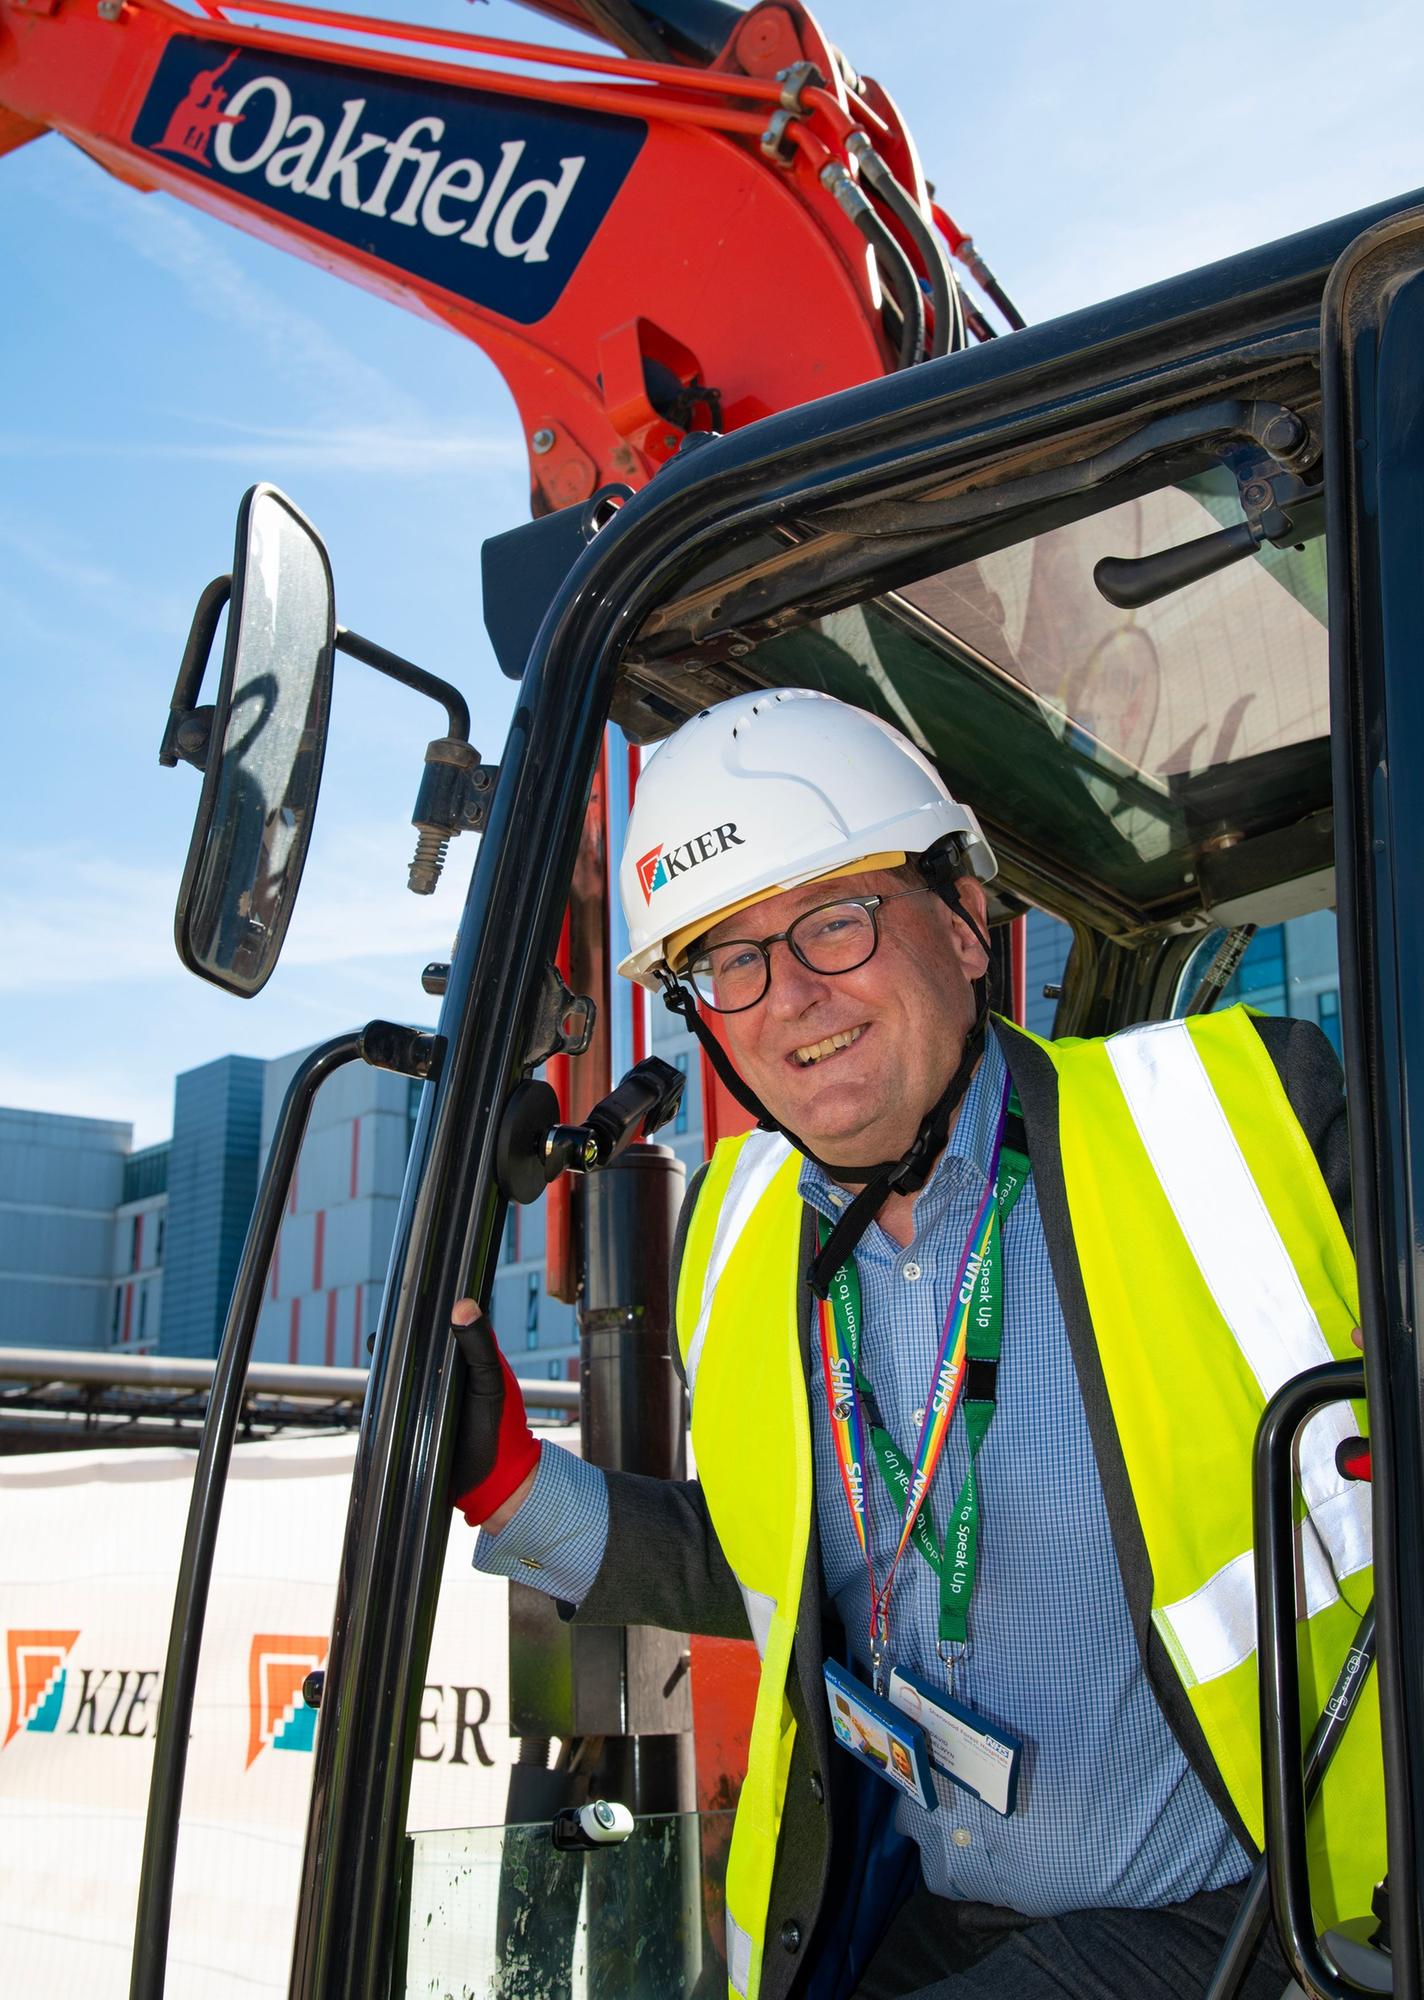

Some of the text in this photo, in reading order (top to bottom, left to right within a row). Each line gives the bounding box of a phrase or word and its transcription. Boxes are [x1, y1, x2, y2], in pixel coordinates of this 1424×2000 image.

[214, 76, 586, 263] Oakfield
[662, 822, 746, 880] KIER
[999, 1175, 1018, 1207] Free
[840, 1284, 850, 1301] to
[980, 1259, 993, 1303] Speak
[976, 1307, 993, 1328] Up
[830, 1357, 855, 1407] NHS
[932, 1359, 960, 1418] NHS
[884, 1450, 900, 1469] Up
[845, 1462, 865, 1513] NHS
[949, 1506, 973, 1594] to Speak Up
[67, 1669, 193, 1738] KIE
[415, 1684, 496, 1767] ER
[985, 1736, 1010, 1758] NHS
